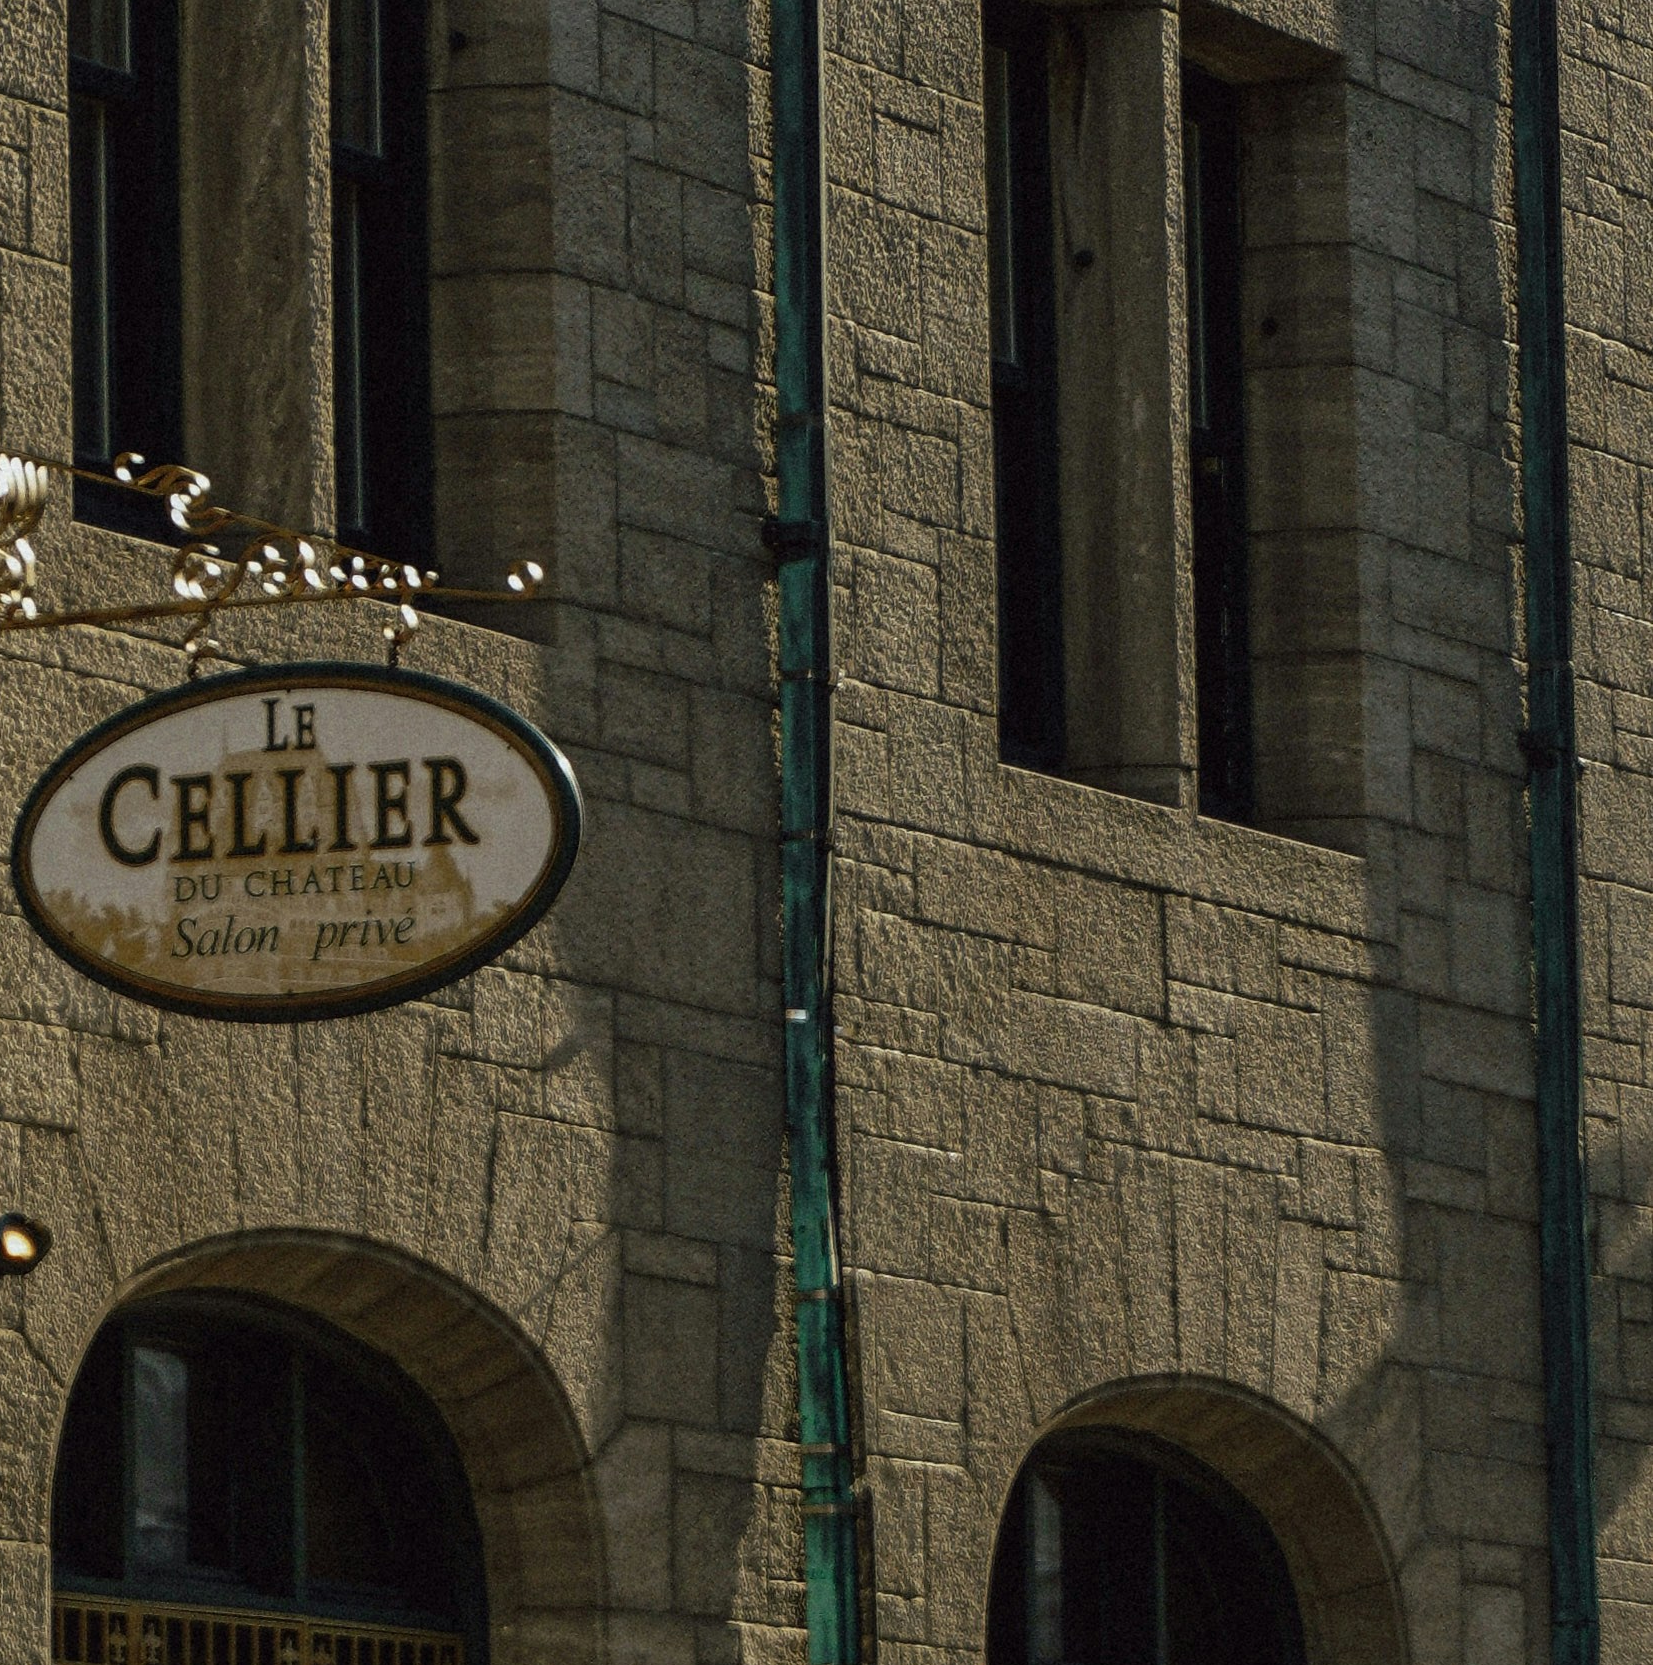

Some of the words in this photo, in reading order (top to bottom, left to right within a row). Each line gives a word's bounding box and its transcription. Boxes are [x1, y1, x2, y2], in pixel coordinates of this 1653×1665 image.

[260, 697, 317, 752] LE
[98, 756, 481, 866] CELLIER
[173, 874, 223, 902] DU
[244, 861, 416, 898] CHATEAU
[171, 915, 279, 958] Salon
[309, 907, 416, 960] privé
